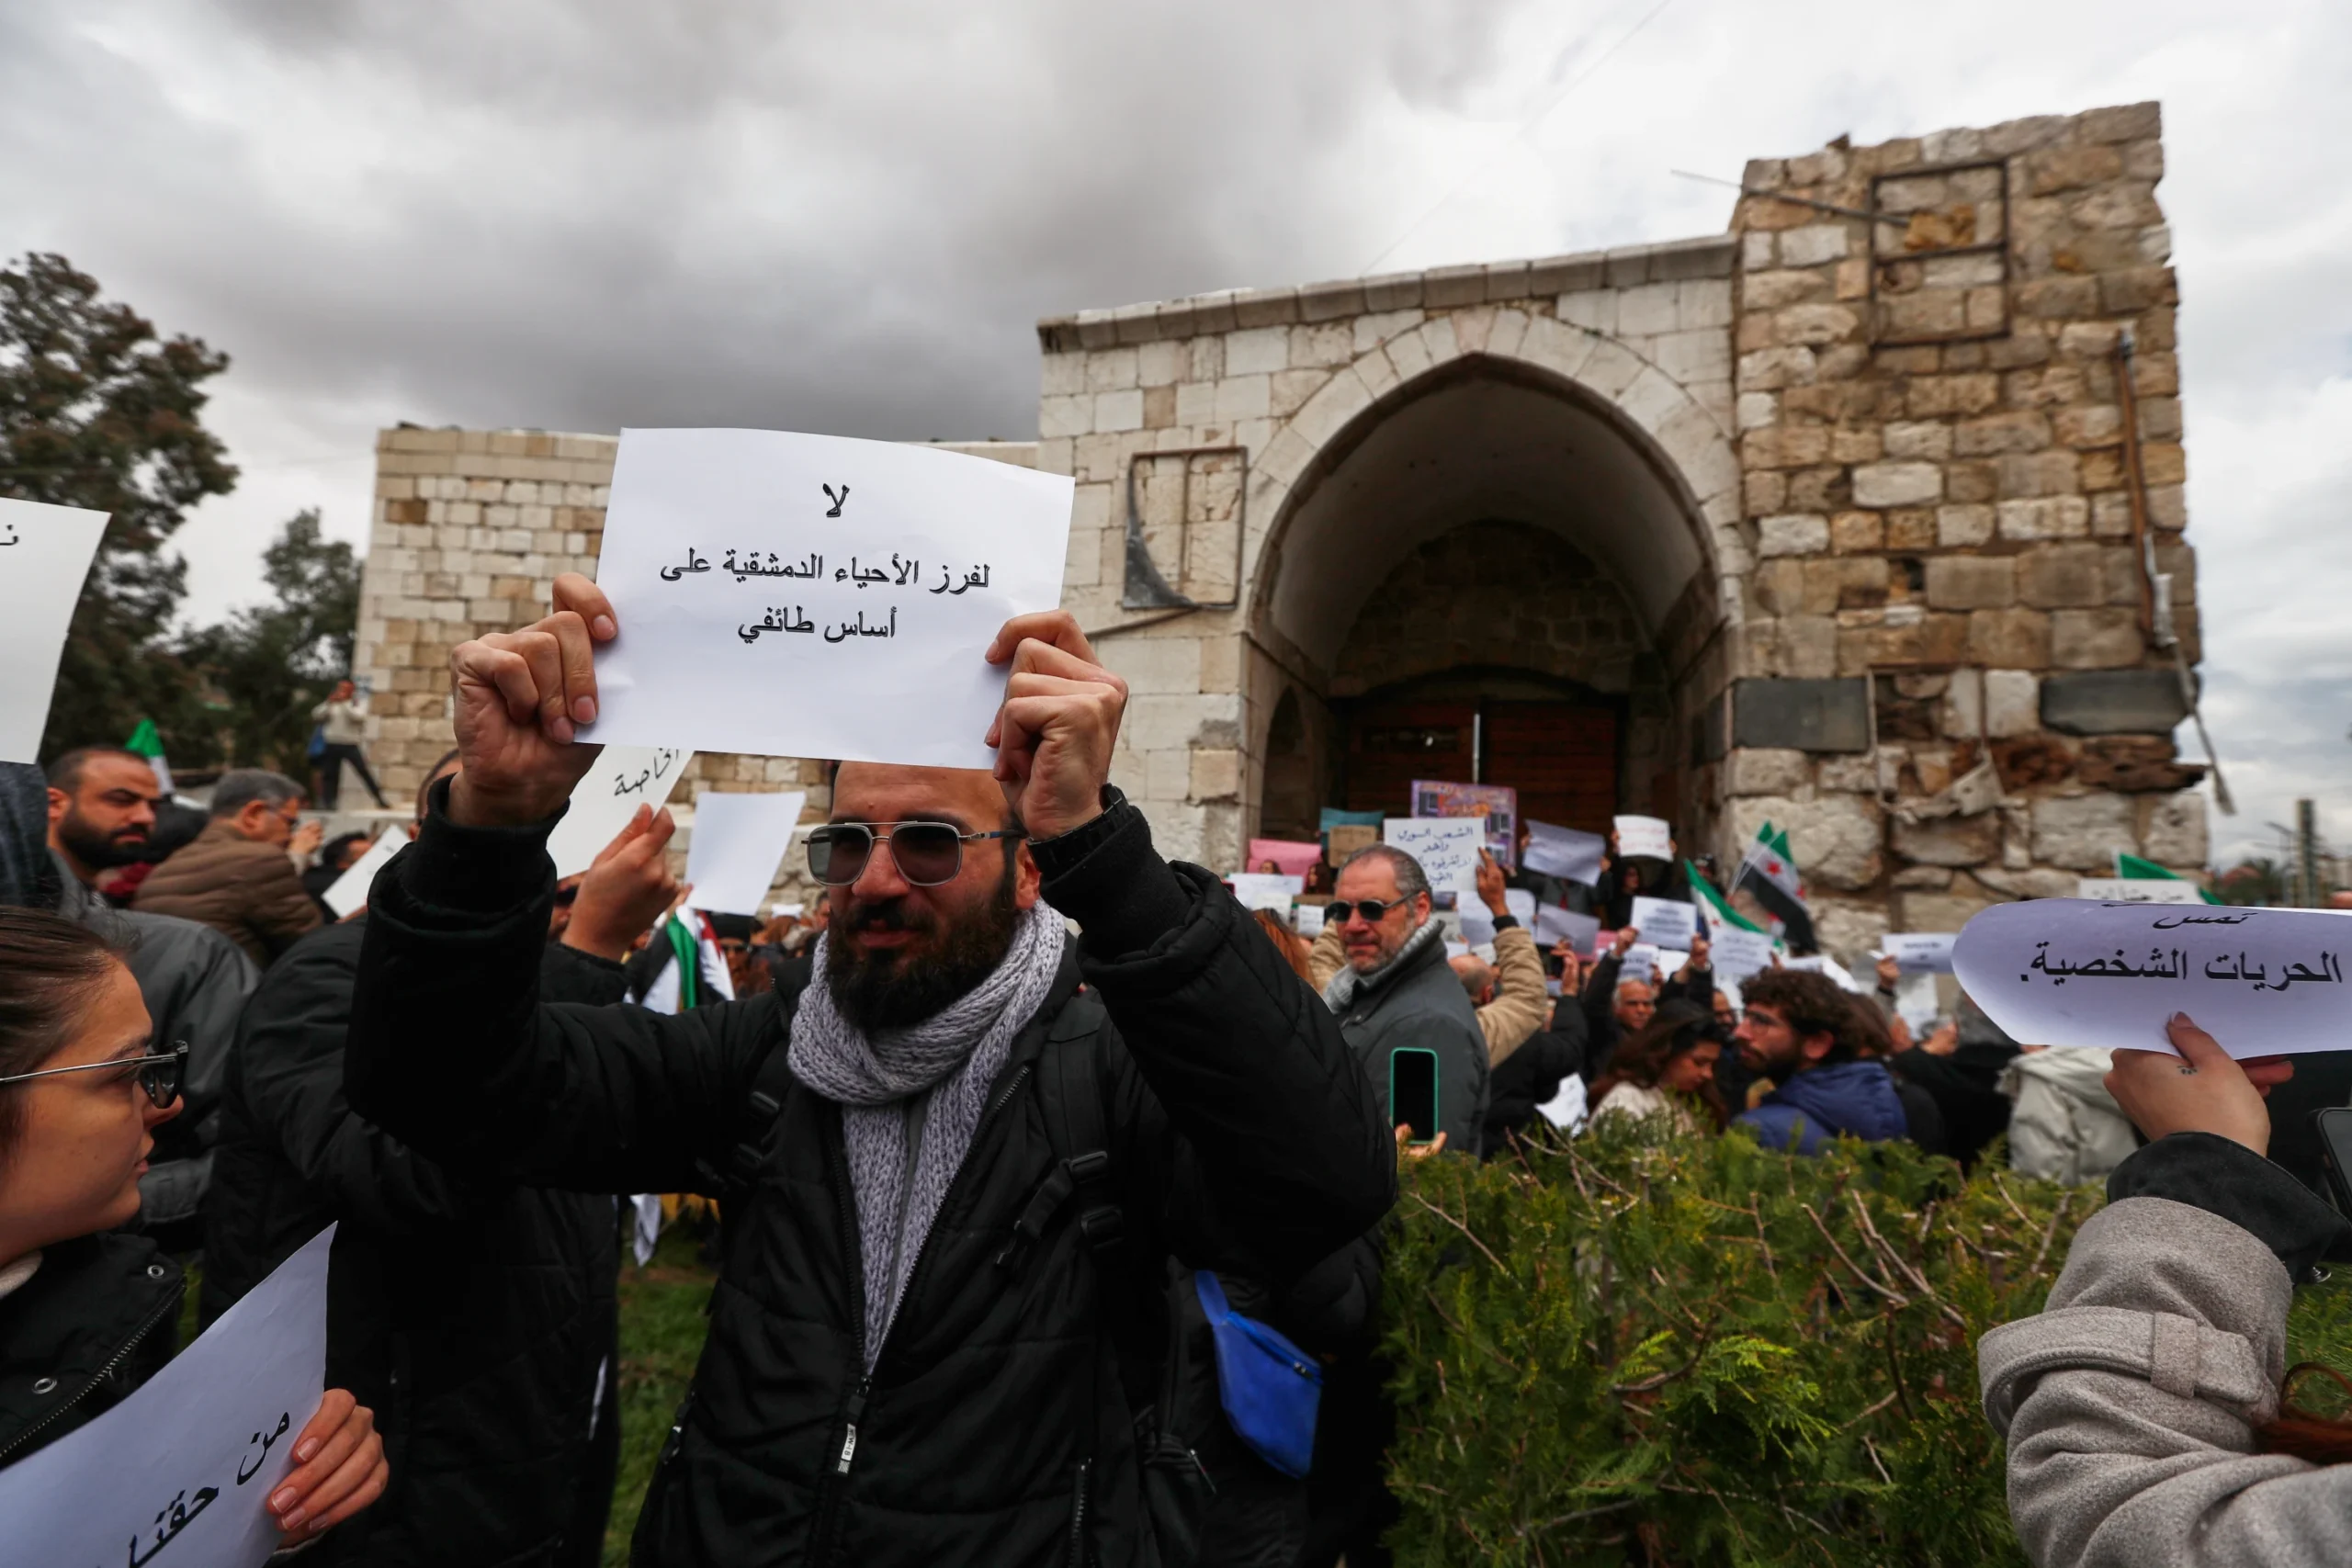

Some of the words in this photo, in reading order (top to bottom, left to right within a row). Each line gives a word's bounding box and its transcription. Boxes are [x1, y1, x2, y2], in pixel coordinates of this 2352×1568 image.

[822, 483, 850, 518] لا
[660, 547, 712, 581] على
[722, 549, 823, 583] الدمشقية
[834, 553, 920, 590] الأحياء
[929, 564, 990, 595] لفرز
[737, 605, 815, 645] طائفي
[823, 606, 898, 644] أساس
[2019, 941, 2188, 987] الشخصية.
[2204, 951, 2343, 992] الحريات
[236, 1412, 290, 1486] من
[129, 1487, 220, 1568] حقنا
